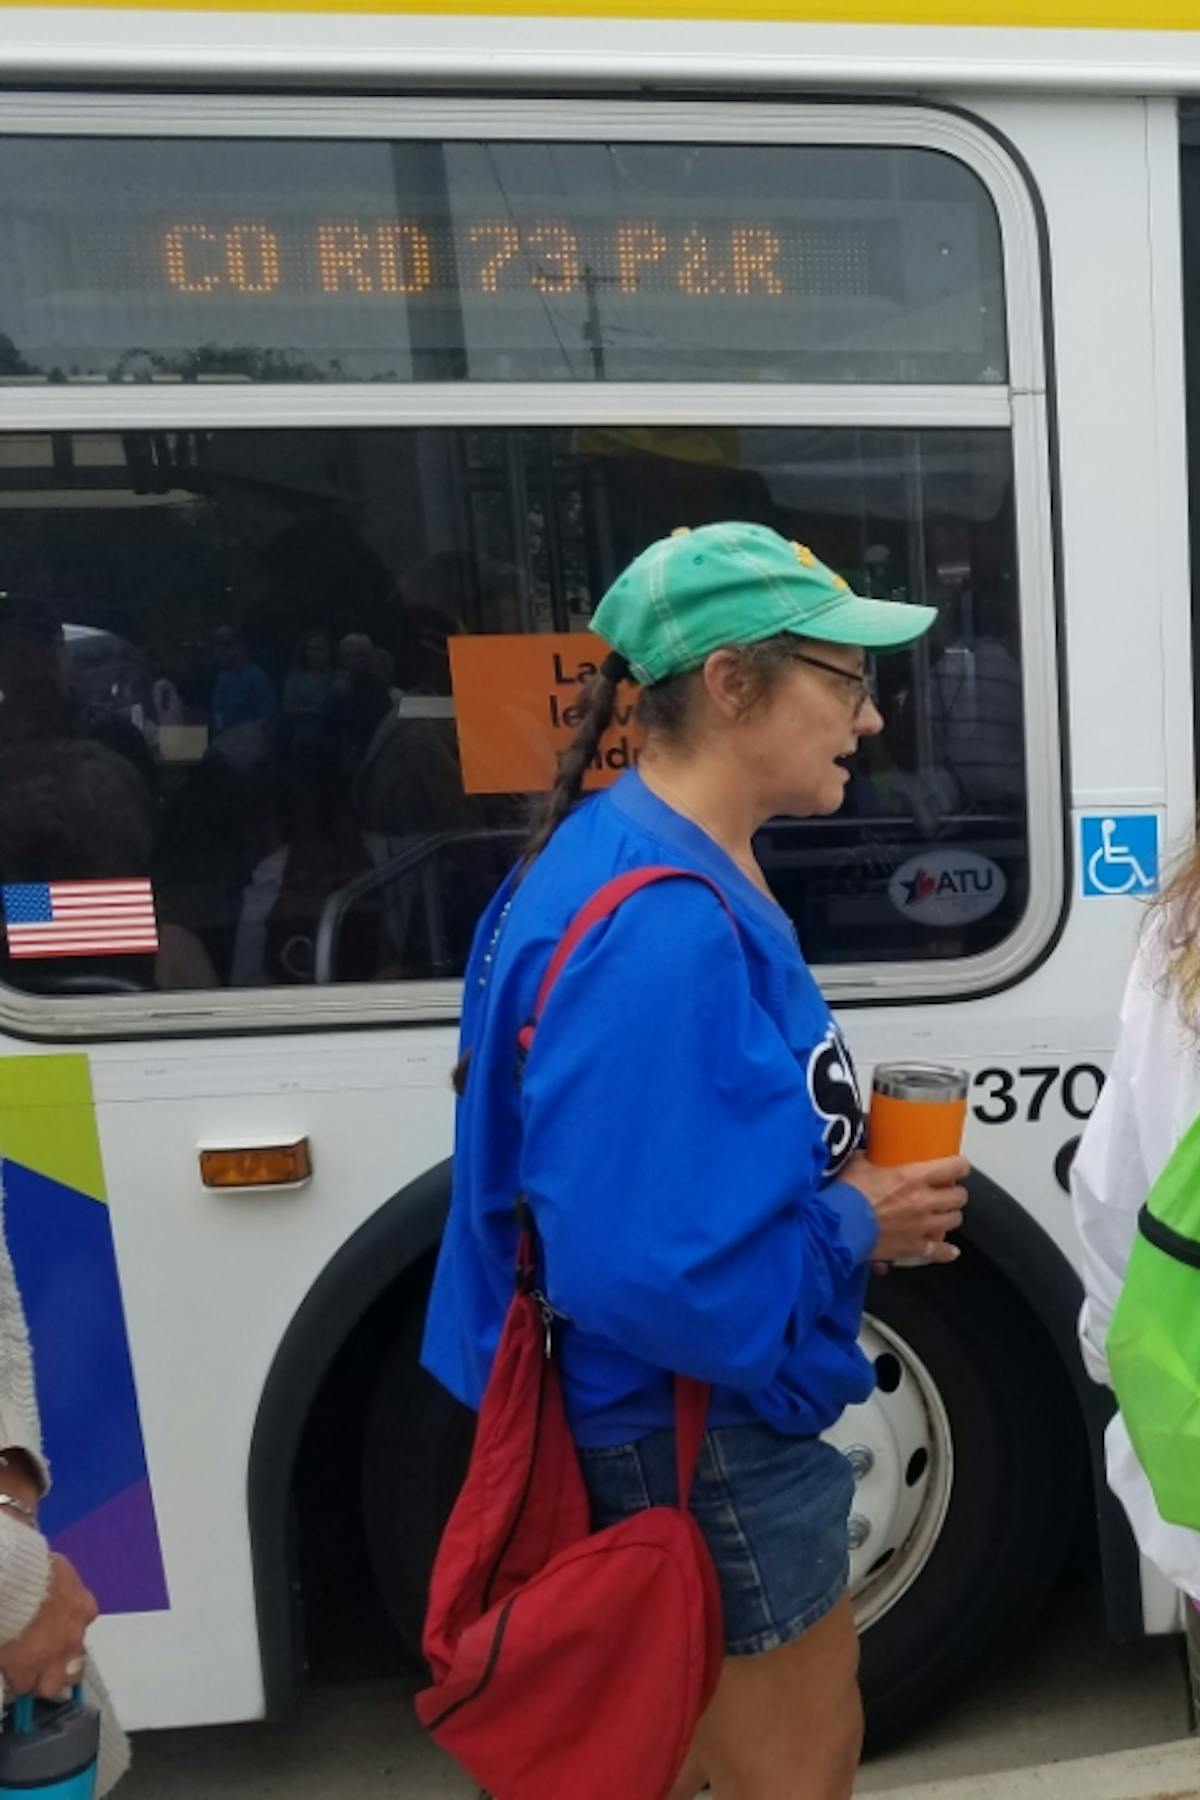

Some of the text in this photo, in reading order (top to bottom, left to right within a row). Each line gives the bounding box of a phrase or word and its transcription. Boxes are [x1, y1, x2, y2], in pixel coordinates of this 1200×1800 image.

[164, 223, 783, 295] CO RD 73 P&R
[552, 652, 598, 685] La
[937, 868, 993, 894] ATU
[972, 1062, 1107, 1126] 370
